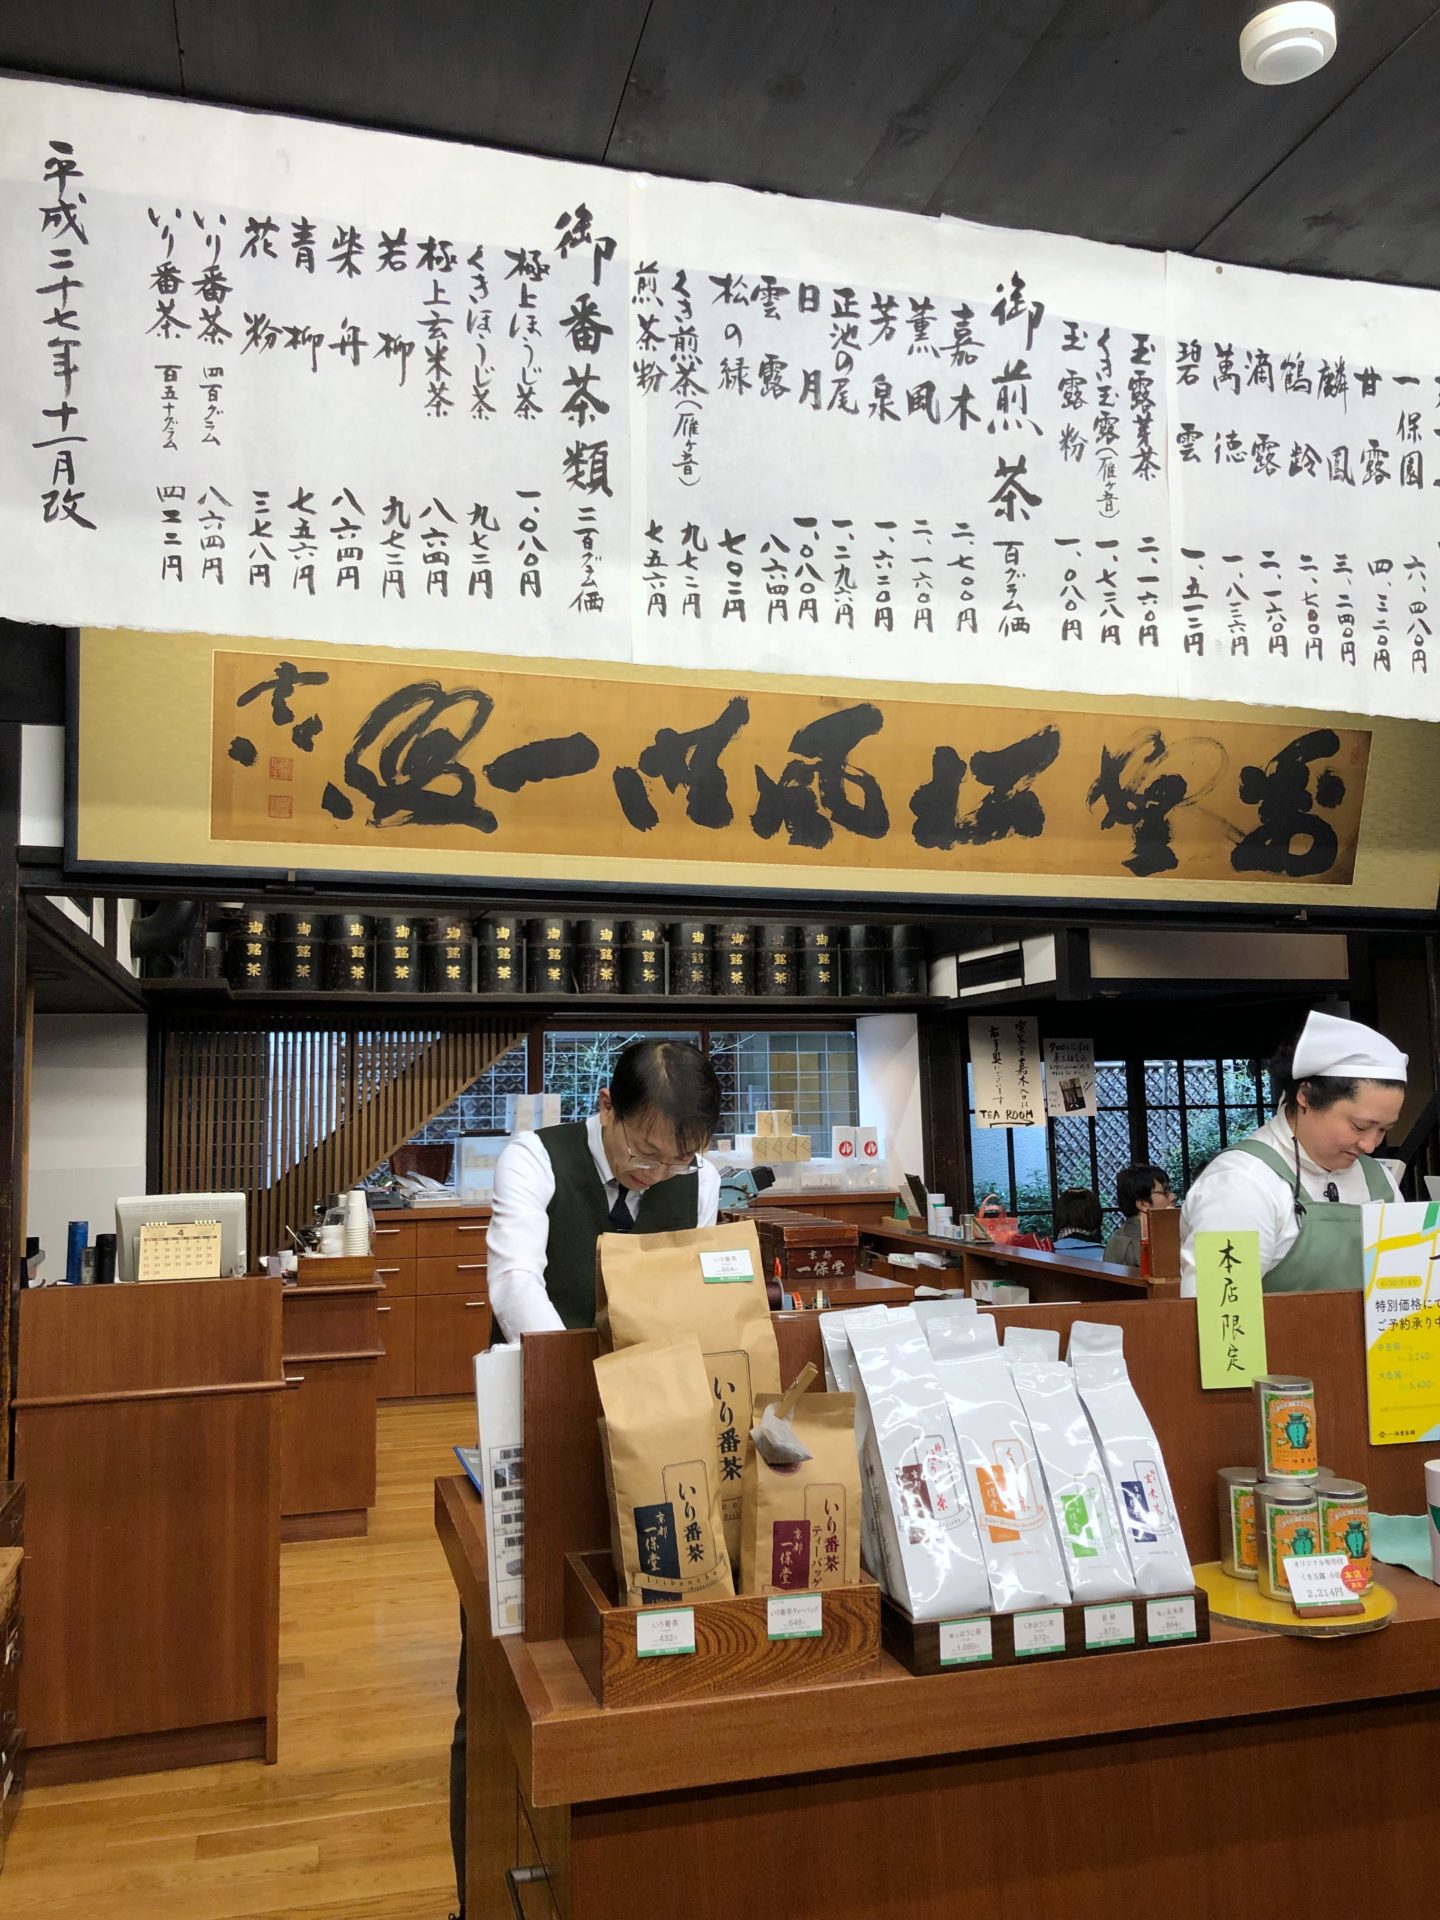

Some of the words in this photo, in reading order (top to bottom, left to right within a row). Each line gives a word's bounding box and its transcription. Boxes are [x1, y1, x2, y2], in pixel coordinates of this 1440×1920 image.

[148, 208, 191, 338] いり番茶
[192, 211, 232, 344] いり番茶
[240, 216, 283, 354] 花粉
[282, 216, 324, 372] 青柳
[374, 228, 415, 386] 若柳
[416, 236, 457, 417] 極上玄米茶
[467, 245, 496, 420] くきほうじ茶
[505, 248, 550, 419] 極上ほうじ茶
[632, 261, 667, 392] 煎茶粉
[709, 273, 751, 395] 松の緑
[32, 141, 97, 530] 平成二十七年十一月改
[555, 203, 617, 497] 御番茶類
[752, 276, 790, 399] 雲露
[799, 283, 821, 409] 日月
[828, 288, 861, 414] 正池の尾
[869, 292, 900, 421] 芳泉
[906, 297, 939, 424] 薫風
[941, 303, 984, 430] 嘉木
[988, 271, 1044, 521] 御煎茶
[1058, 321, 1088, 462] 玉露粉
[200, 367, 223, 445] 四百グラム
[1128, 334, 1160, 480] 玉露芽茶
[1176, 339, 1203, 462] 碧雲
[1213, 343, 1249, 463] 萬徳
[1243, 349, 1284, 476] 滴露
[1352, 367, 1391, 486] 甘露
[1389, 377, 1423, 489] 一保園
[198, 486, 232, 584] 八六四円
[249, 491, 276, 587] 三七八円
[288, 487, 317, 595] 七五六円
[330, 488, 364, 589] 八六四円
[381, 496, 410, 598] 九七二円
[419, 498, 457, 597] 八六四円
[468, 503, 500, 598] 九七二円
[643, 520, 668, 617] 七五六円
[677, 522, 708, 618] 九七二円
[761, 534, 790, 624] 八六四円
[978, 1109, 1001, 1120] TEA
[1005, 1109, 1034, 1120] ROOM
[796, 1260, 846, 1276] 一保堂
[1218, 1238, 1247, 1373] 本店限定
[713, 1376, 743, 1481] いり番茶
[643, 1526, 662, 1572] 一保堂
[656, 1511, 669, 1539] 京都
[678, 1482, 705, 1563] いり番茶
[779, 1541, 794, 1585] 一保堂
[823, 1498, 840, 1572] いり番茶
[1307, 1587, 1344, 1598] 2,214円
